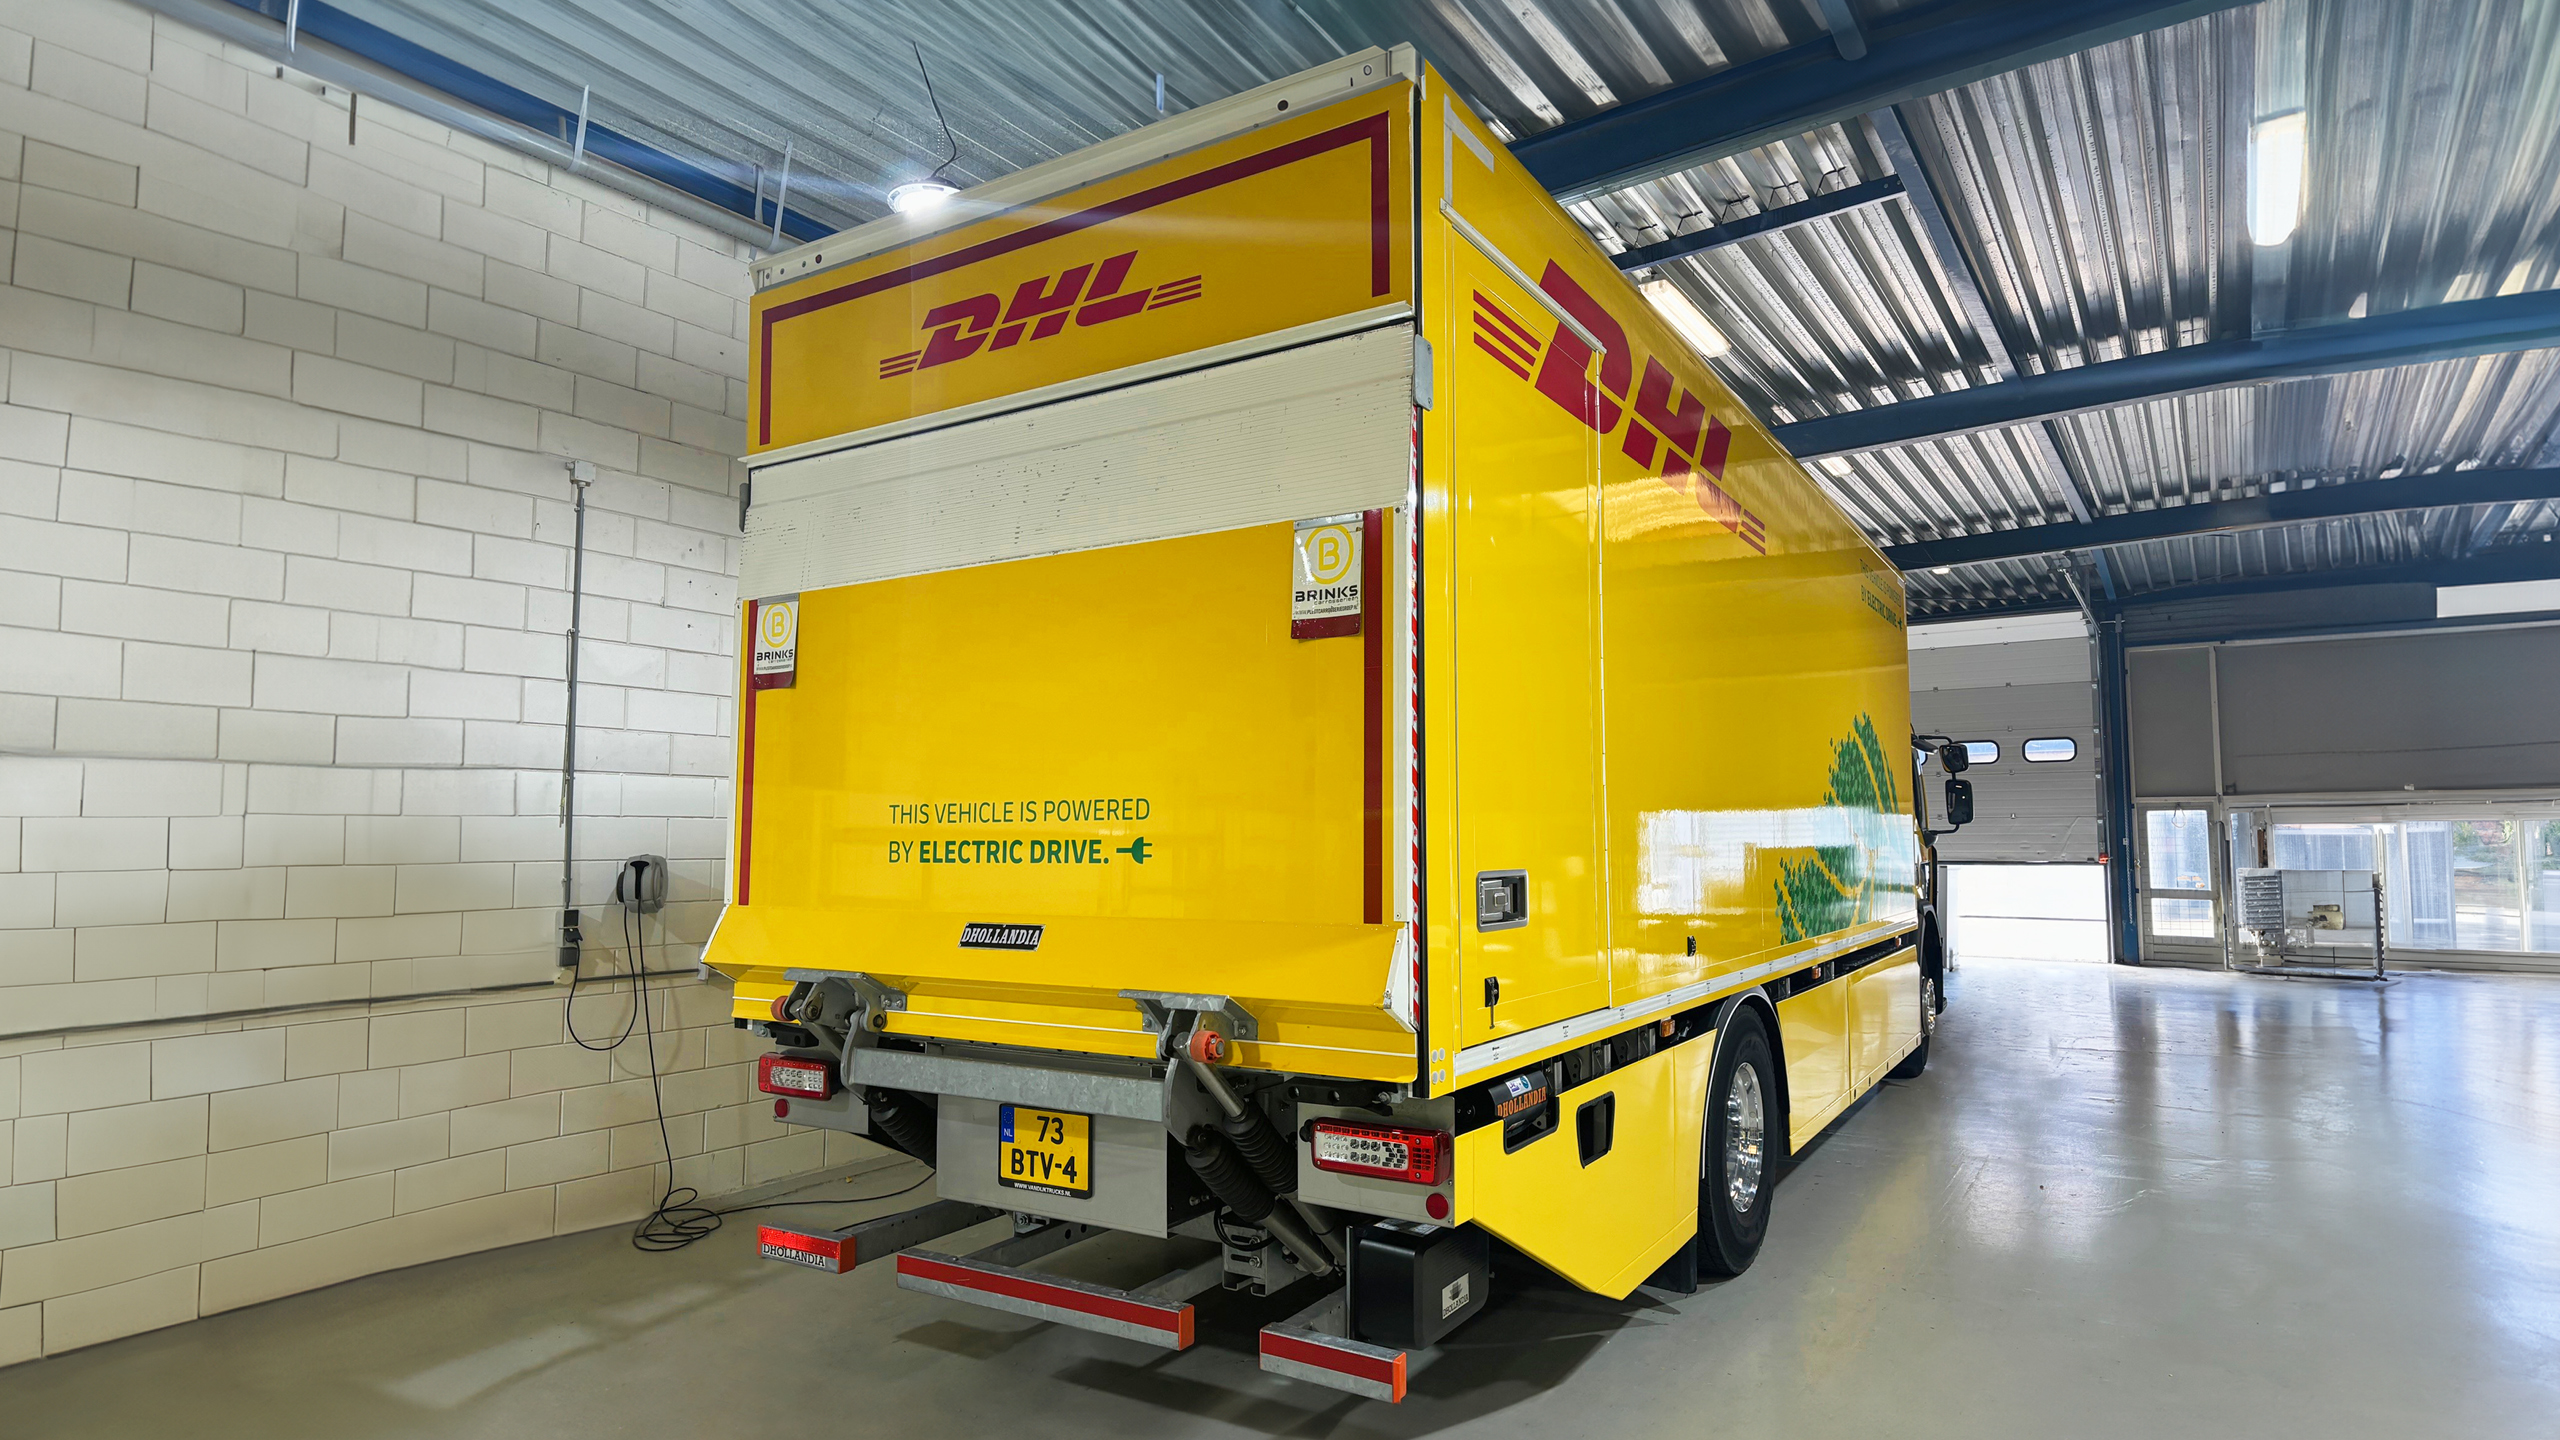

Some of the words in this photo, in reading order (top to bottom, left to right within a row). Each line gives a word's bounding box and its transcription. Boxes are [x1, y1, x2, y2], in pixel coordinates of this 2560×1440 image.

[917, 250, 1153, 370] DHL
[1535, 258, 1742, 534] DHL
[1295, 585, 1358, 602] BRINKS
[756, 649, 793, 661] BRINKS
[889, 804, 929, 824] THIS
[934, 802, 1014, 824] VEHICLE
[1020, 800, 1037, 823] IS
[1044, 798, 1150, 822] POWERED
[888, 841, 914, 863] BY
[919, 840, 1023, 864] ELECTRIC
[1030, 840, 1109, 864] DRIVE.
[961, 927, 1040, 946] DHOLLANDIA
[1497, 1086, 1547, 1118] DHOLLANDIA
[1003, 1128, 1013, 1138] NL
[1037, 1115, 1064, 1145] 73
[1011, 1148, 1077, 1184] BTV-4
[763, 1243, 825, 1267] DHOLLANDIA
[1443, 1293, 1469, 1317] DHOLLANDIA
